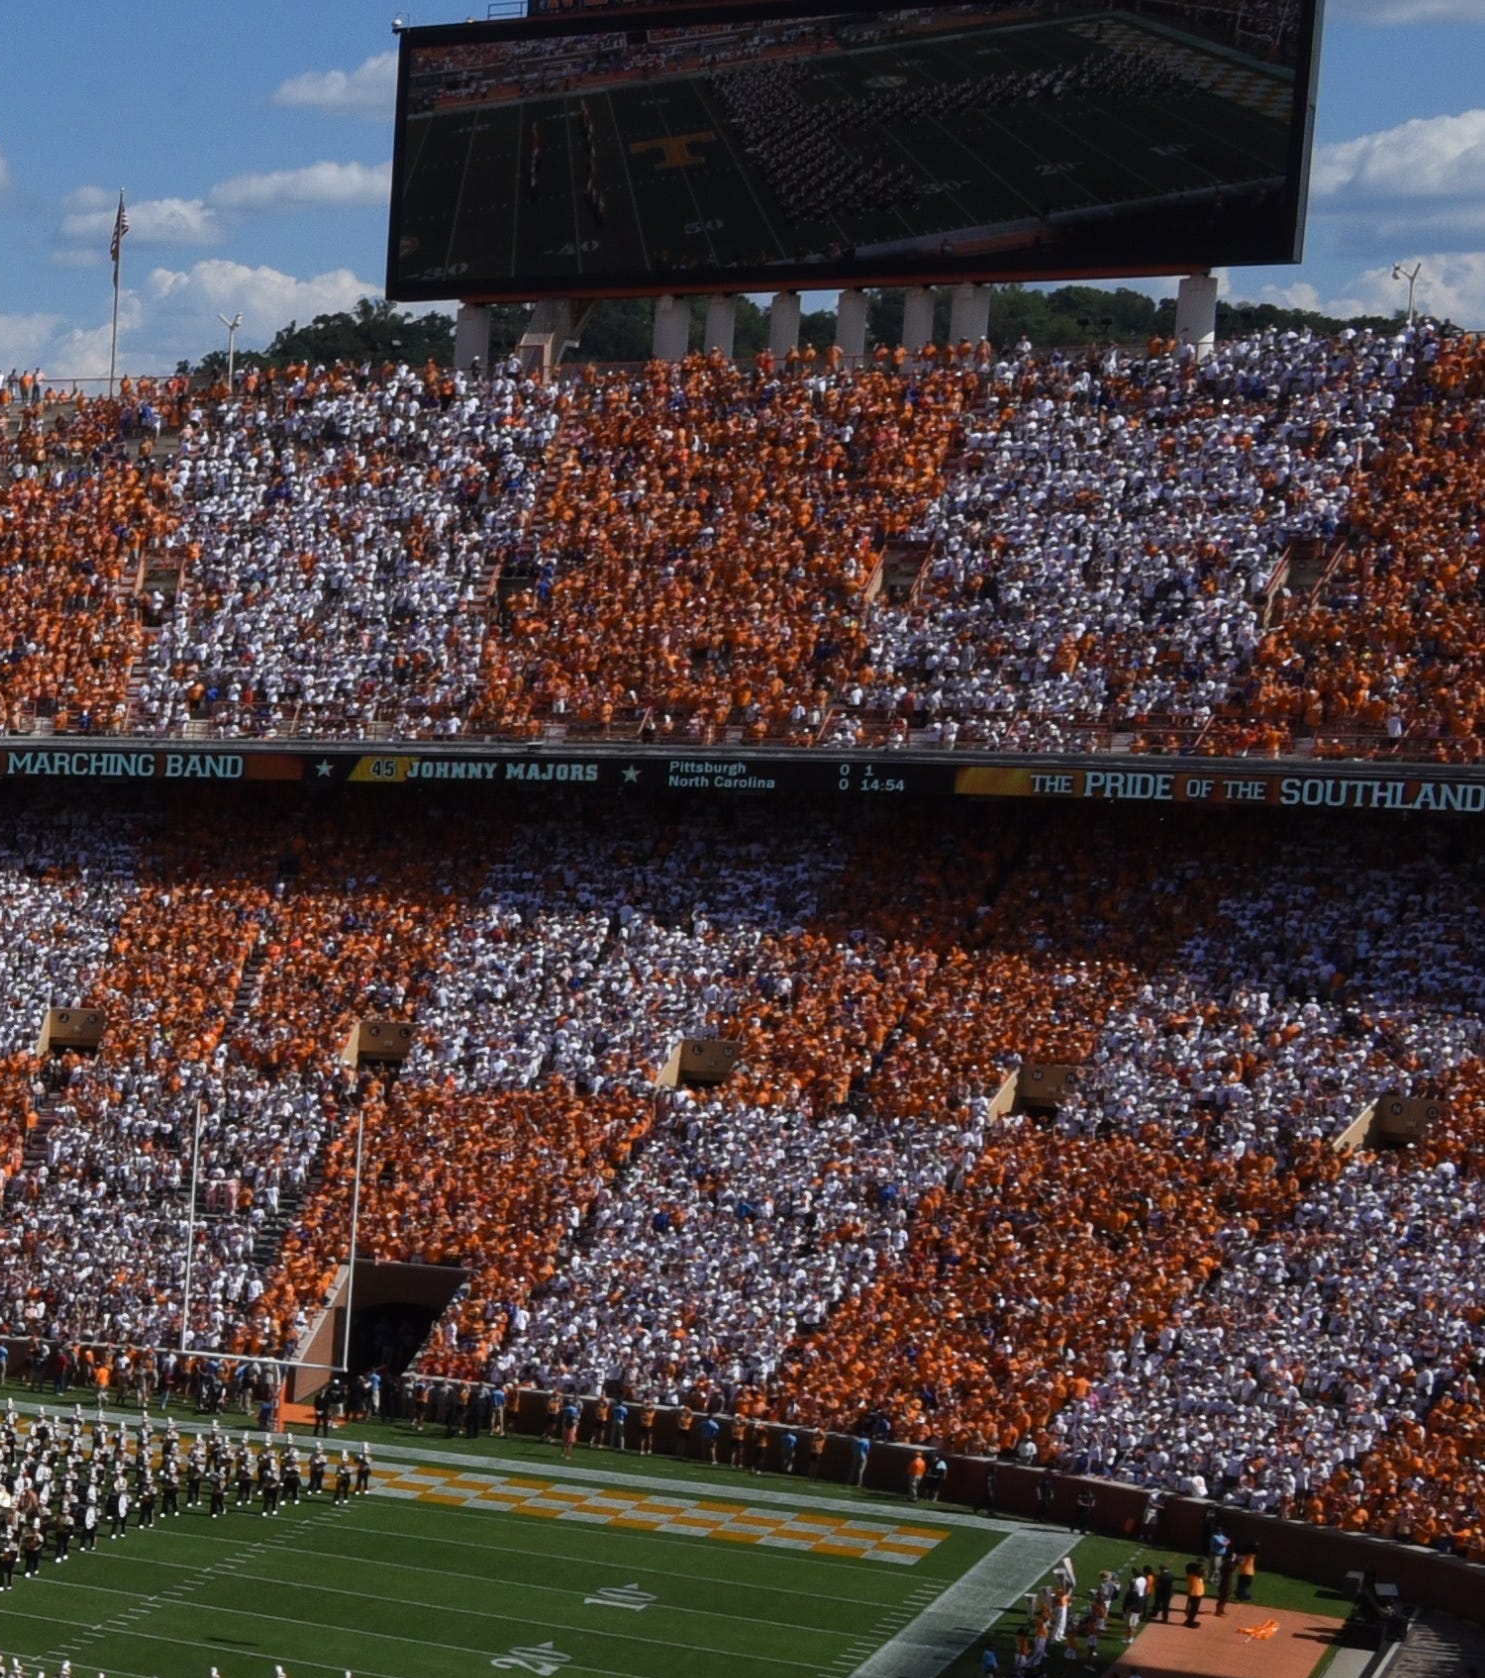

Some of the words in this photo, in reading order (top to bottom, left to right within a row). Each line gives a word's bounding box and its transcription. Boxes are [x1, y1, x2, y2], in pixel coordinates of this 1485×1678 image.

[7, 752, 155, 776] MARCHING
[164, 754, 243, 779] BAND
[370, 761, 397, 778] 45
[407, 761, 497, 780] JOHNNY
[505, 763, 598, 781] MAJORS
[669, 761, 746, 776] Pittsburgh
[840, 764, 849, 776] 0
[865, 764, 873, 776] 1
[668, 775, 710, 788] North
[714, 775, 775, 789] Carolina
[839, 778, 849, 790] 0
[860, 779, 905, 792] 14:54
[1030, 775, 1073, 794] THE
[1084, 771, 1175, 800] PRIDE
[1186, 780, 1214, 798] OF
[1223, 780, 1267, 800] THE
[1279, 779, 1485, 812] SOUTHLAND
[491, 1645, 572, 1677] 20
